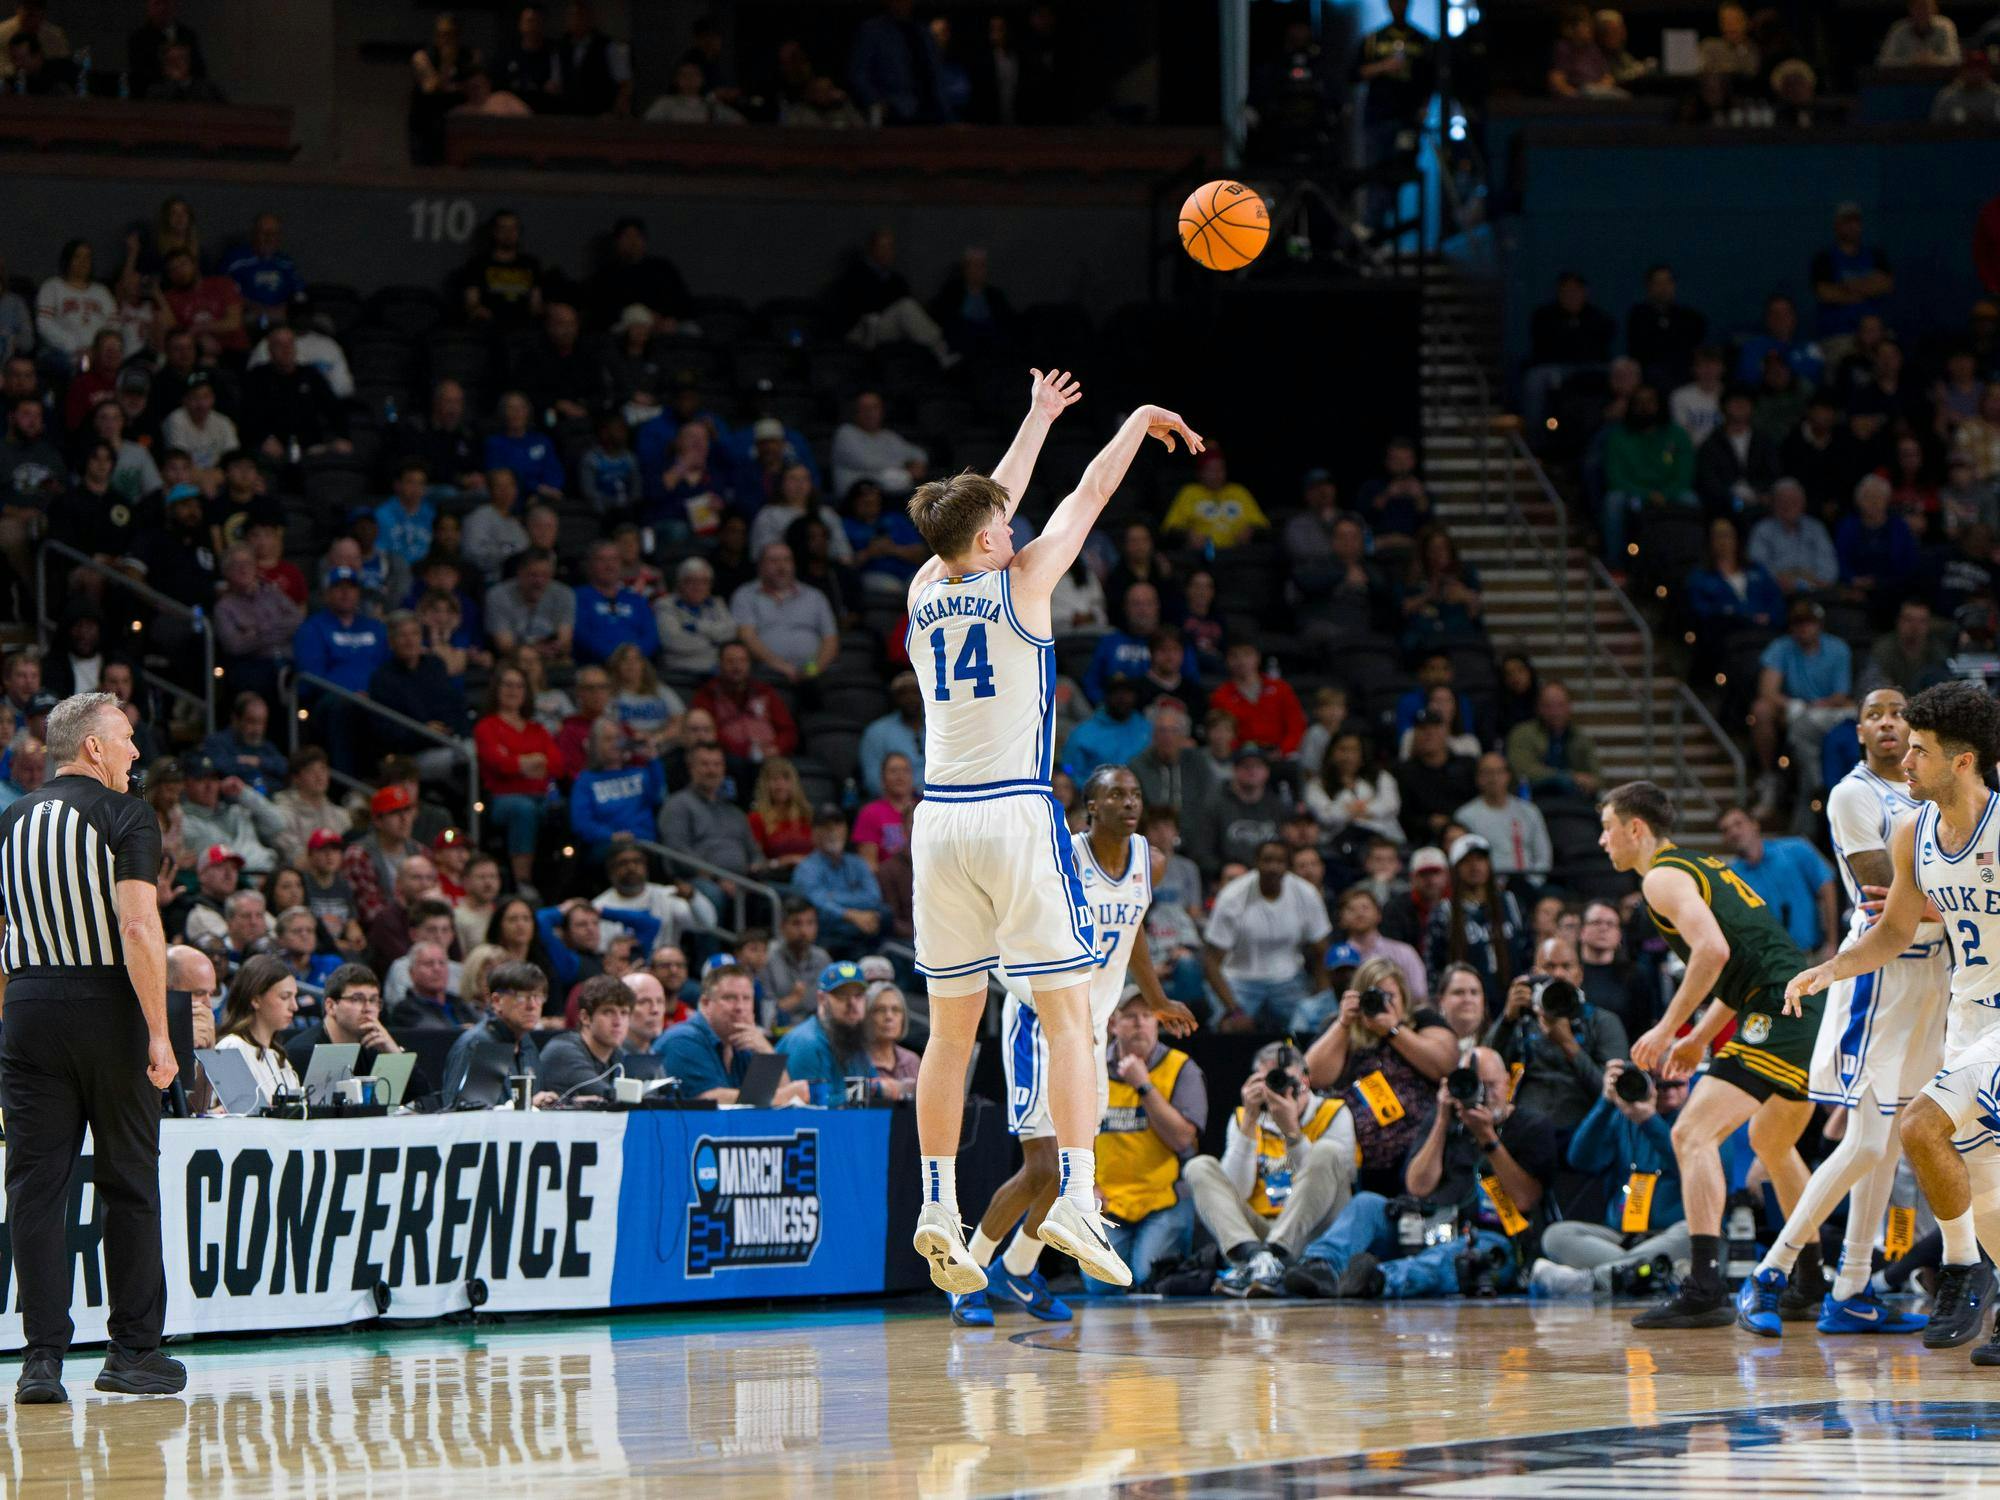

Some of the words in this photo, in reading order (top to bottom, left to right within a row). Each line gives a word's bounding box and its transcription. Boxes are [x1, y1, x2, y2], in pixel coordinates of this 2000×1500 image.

[408, 200, 475, 241] 110
[916, 596, 1001, 630] KHAMENIA
[930, 623, 996, 701] 14
[1957, 919, 1988, 967] 2
[719, 1146, 783, 1195] MARCH
[186, 1141, 598, 1298] CONFERENCE
